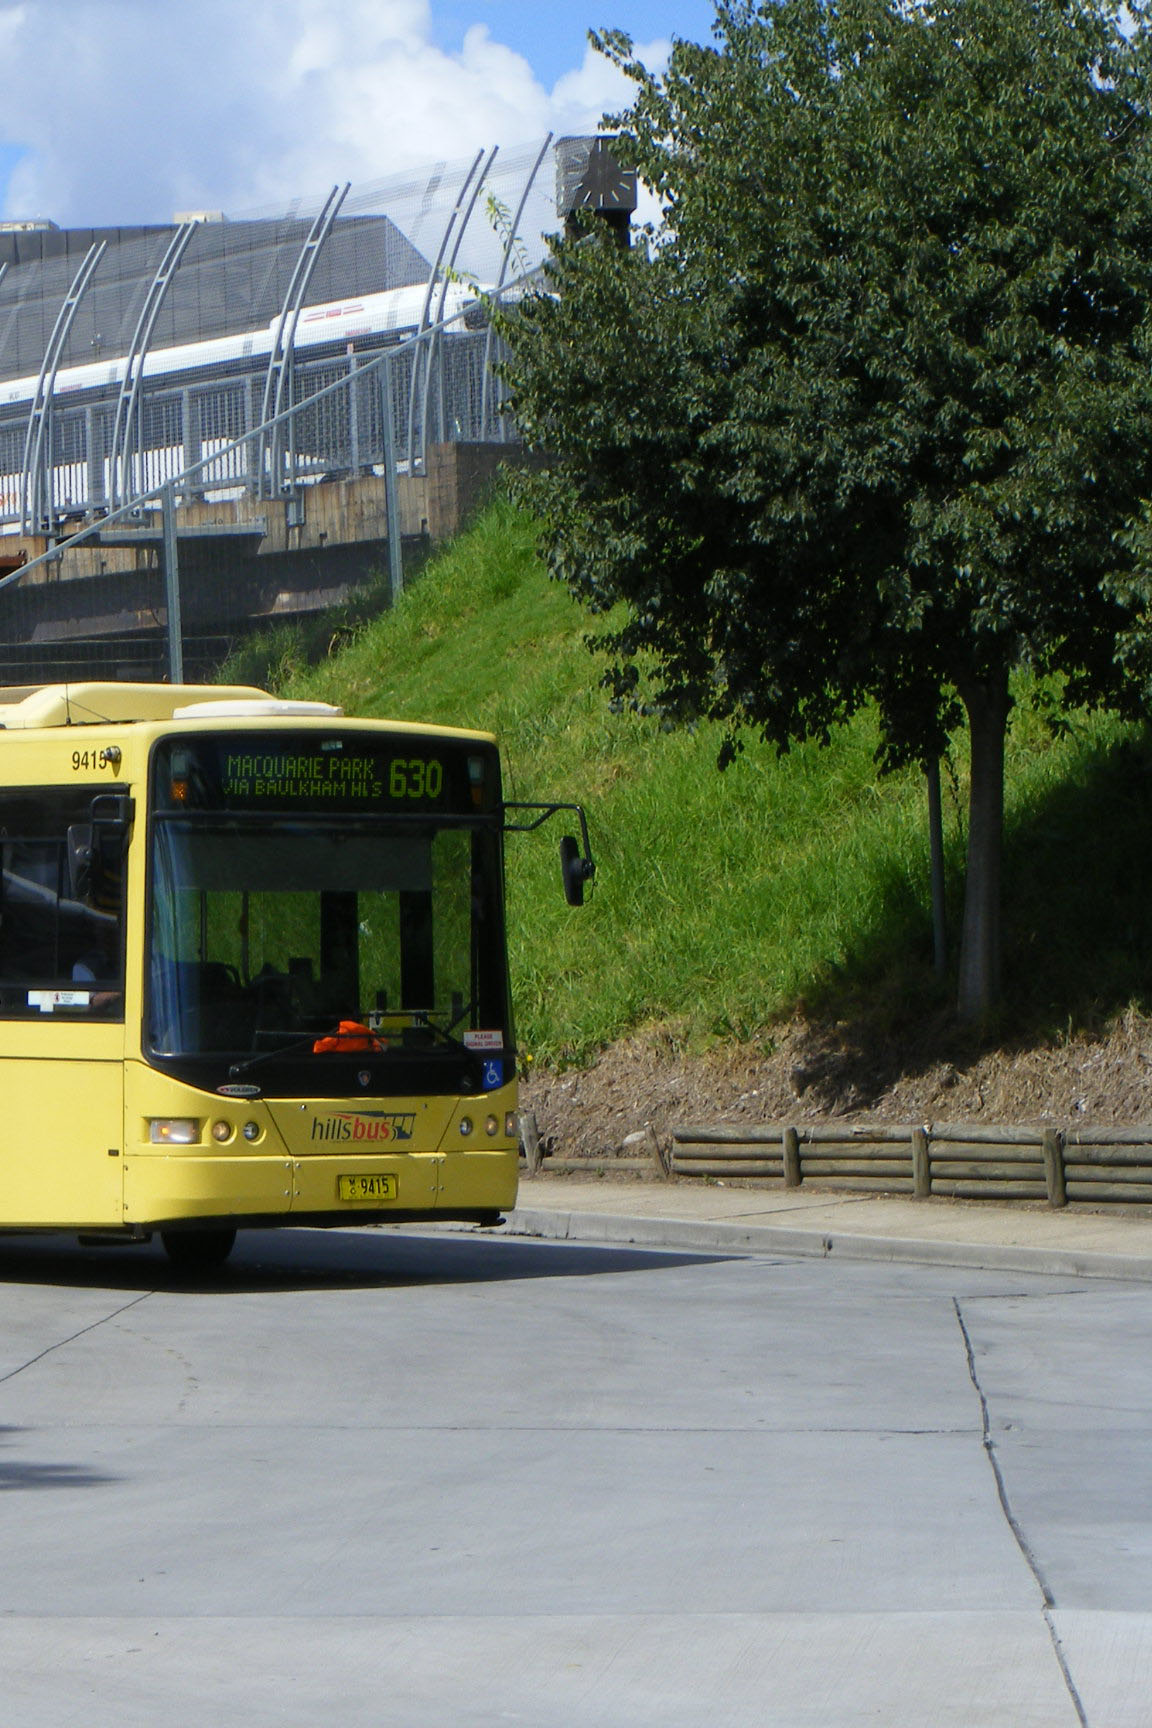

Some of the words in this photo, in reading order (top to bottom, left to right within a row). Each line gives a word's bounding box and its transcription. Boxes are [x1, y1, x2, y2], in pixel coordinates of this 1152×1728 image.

[72, 750, 108, 771] 9415
[228, 755, 324, 779] MACQUARIE
[329, 757, 375, 780] PARK
[223, 779, 249, 795] VIA
[255, 779, 346, 797] BAULKHAM
[390, 759, 443, 798] 630
[311, 1116, 391, 1141] hillsbus
[361, 1177, 389, 1195] 9415
